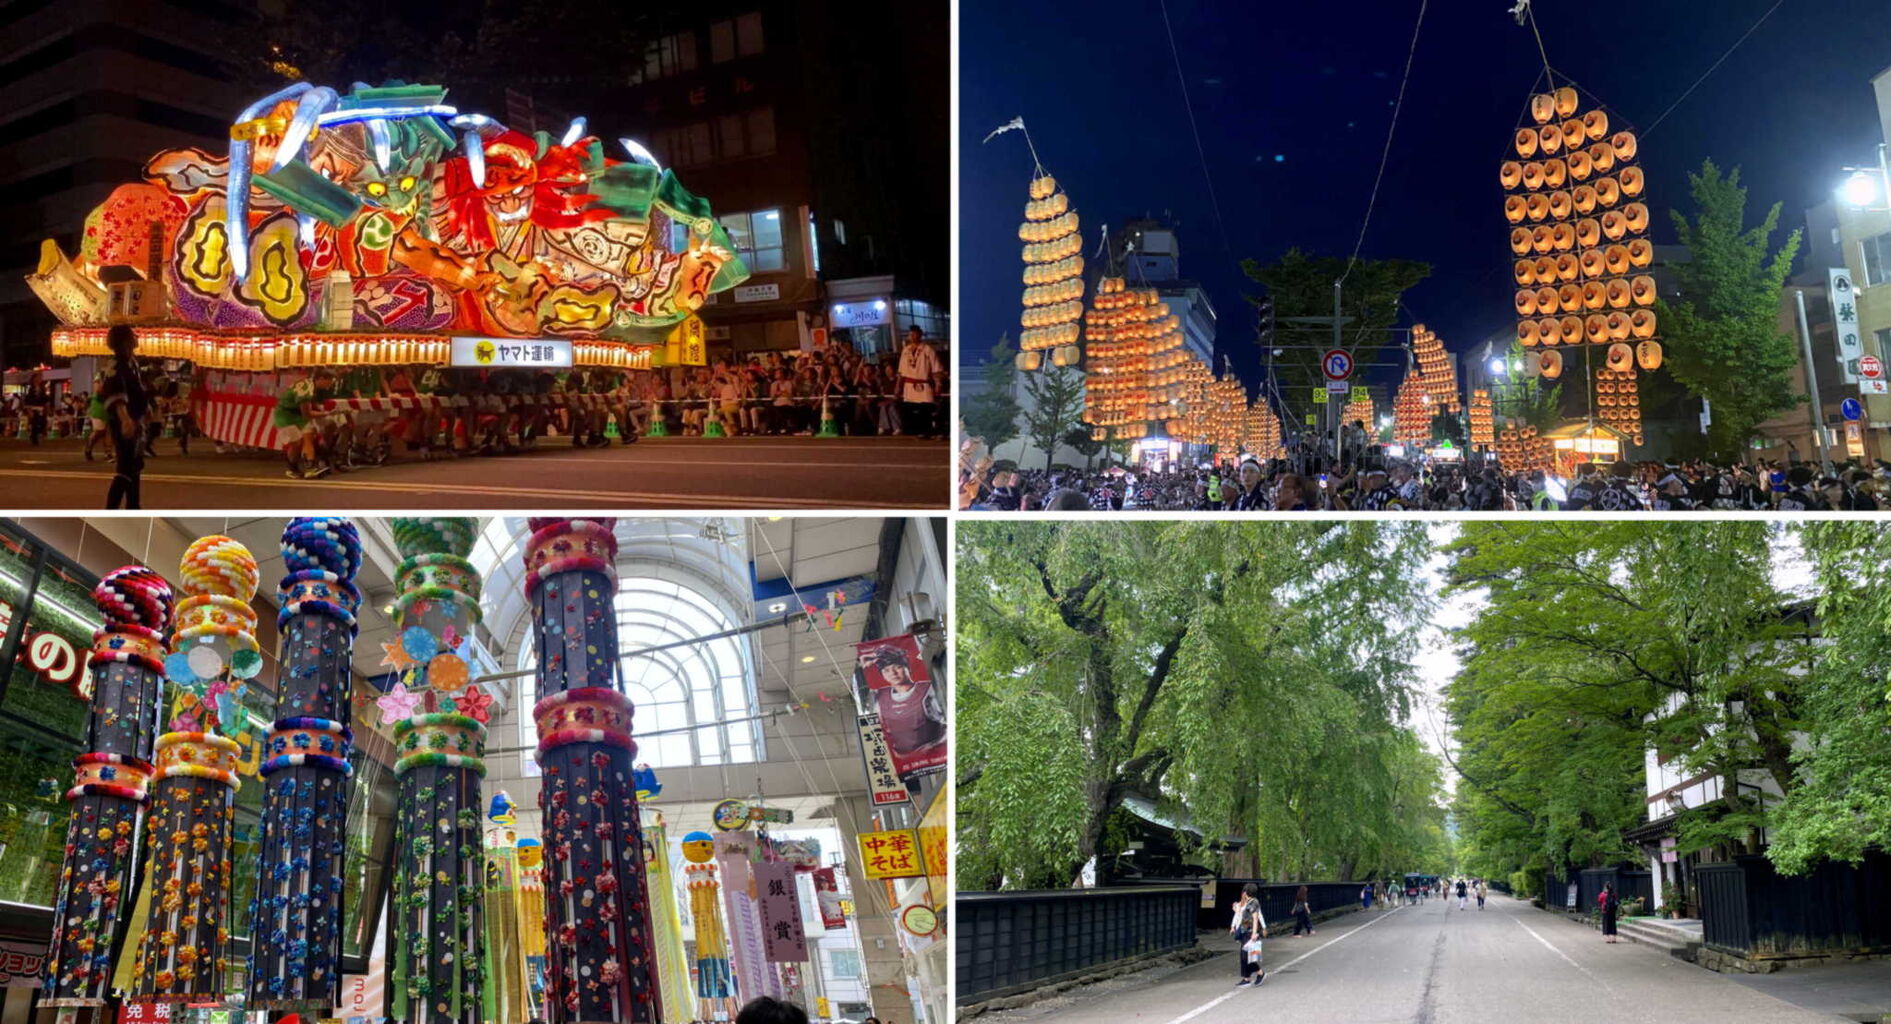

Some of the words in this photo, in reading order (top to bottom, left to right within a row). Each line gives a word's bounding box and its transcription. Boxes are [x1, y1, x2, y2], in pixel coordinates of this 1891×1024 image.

[498, 344, 555, 362] ヤマト運輸
[1314, 389, 1328, 398] 93
[1353, 388, 1367, 397] 94
[864, 834, 912, 854] 中華
[869, 851, 914, 872] そば
[767, 879, 793, 941] 銀賞
[126, 1003, 171, 1019] 免税
